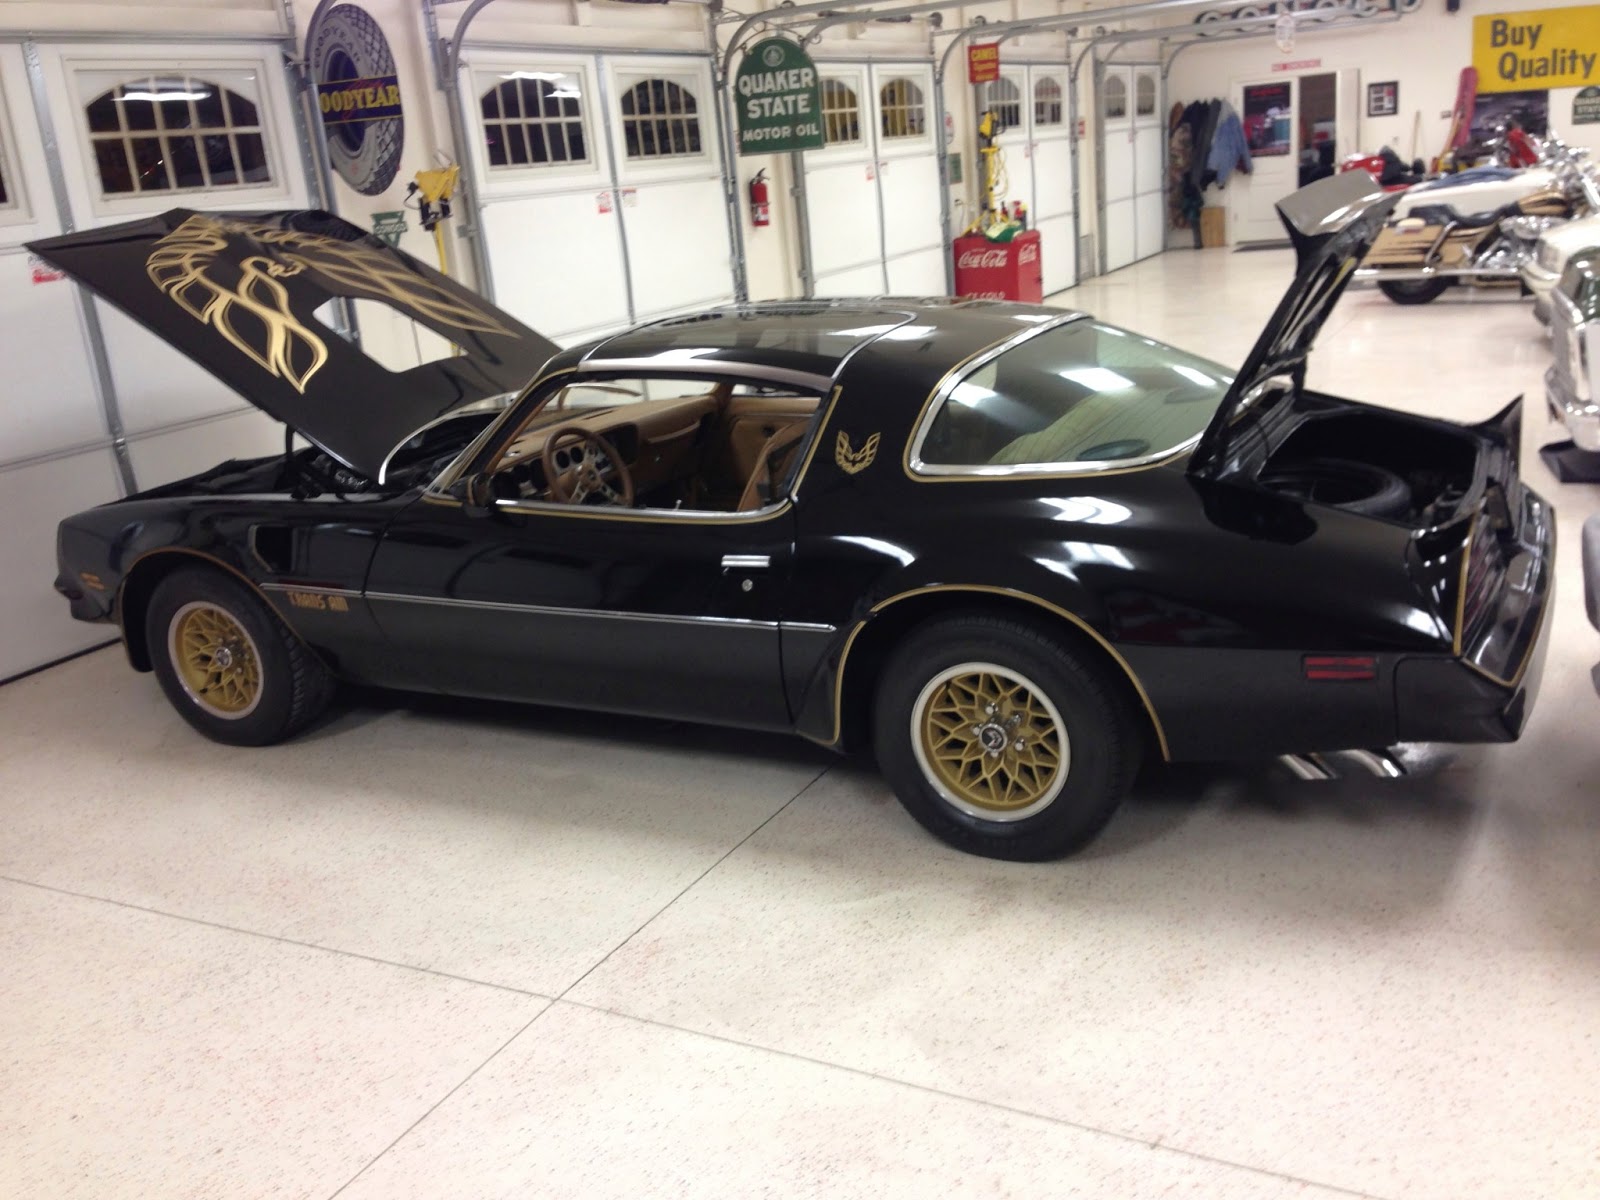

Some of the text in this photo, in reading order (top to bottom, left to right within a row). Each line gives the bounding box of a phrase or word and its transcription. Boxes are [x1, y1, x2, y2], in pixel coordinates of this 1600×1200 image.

[1490, 19, 1543, 50] Buy
[1498, 48, 1597, 82] Quality
[738, 67, 815, 97] QUAKER
[319, 85, 400, 113] OODYEAR
[746, 93, 811, 119] STATE
[742, 122, 819, 142] MOTOR OIL
